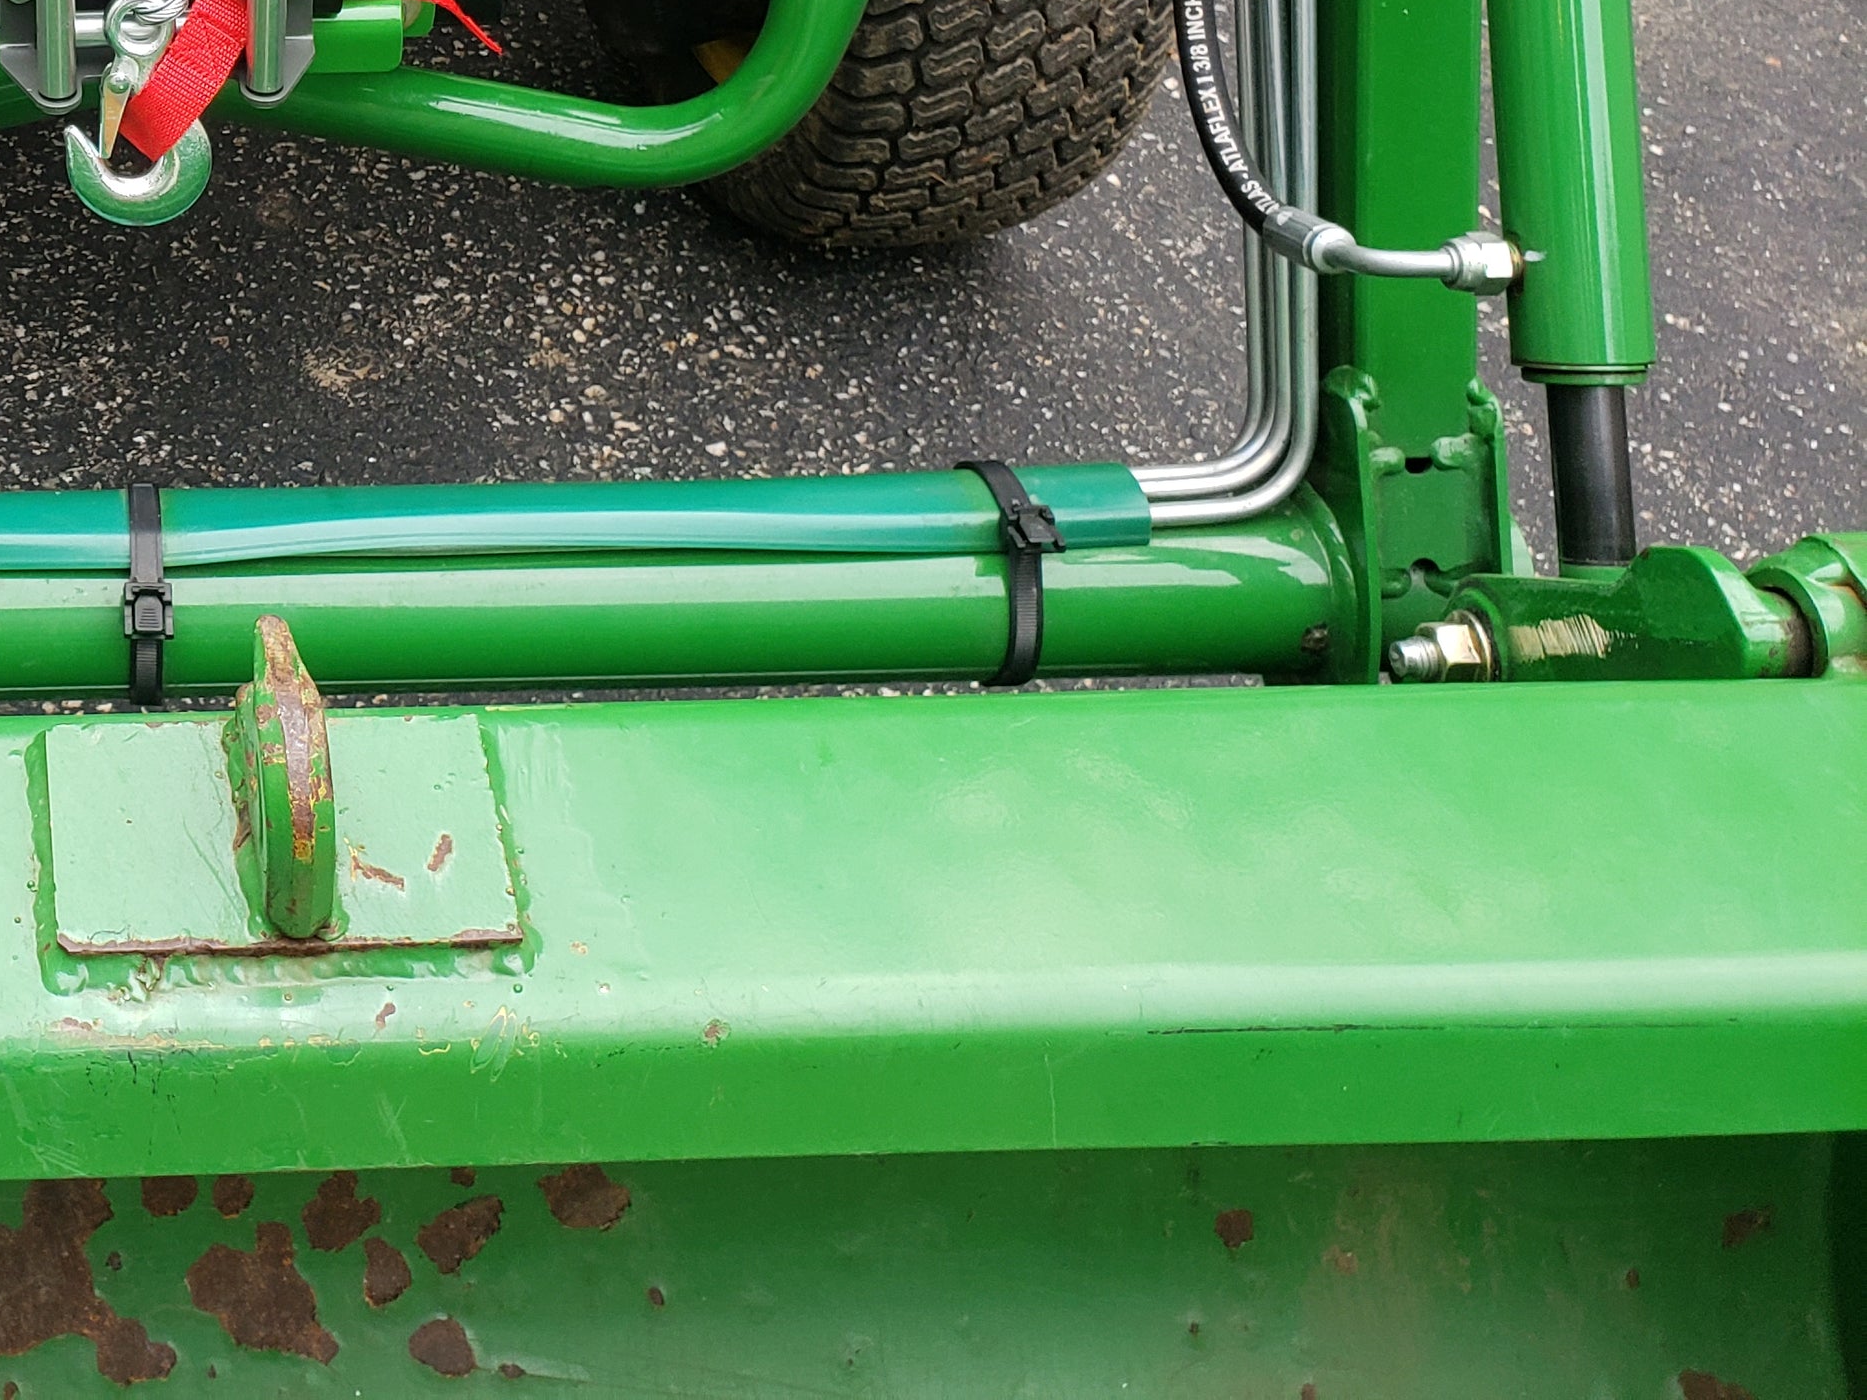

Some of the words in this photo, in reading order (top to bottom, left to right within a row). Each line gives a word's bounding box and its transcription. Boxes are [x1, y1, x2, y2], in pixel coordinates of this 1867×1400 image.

[1190, 43, 1211, 72] 3/8
[1197, 86, 1249, 173] ATLAFLEX
[1241, 179, 1281, 216] ATLAS
